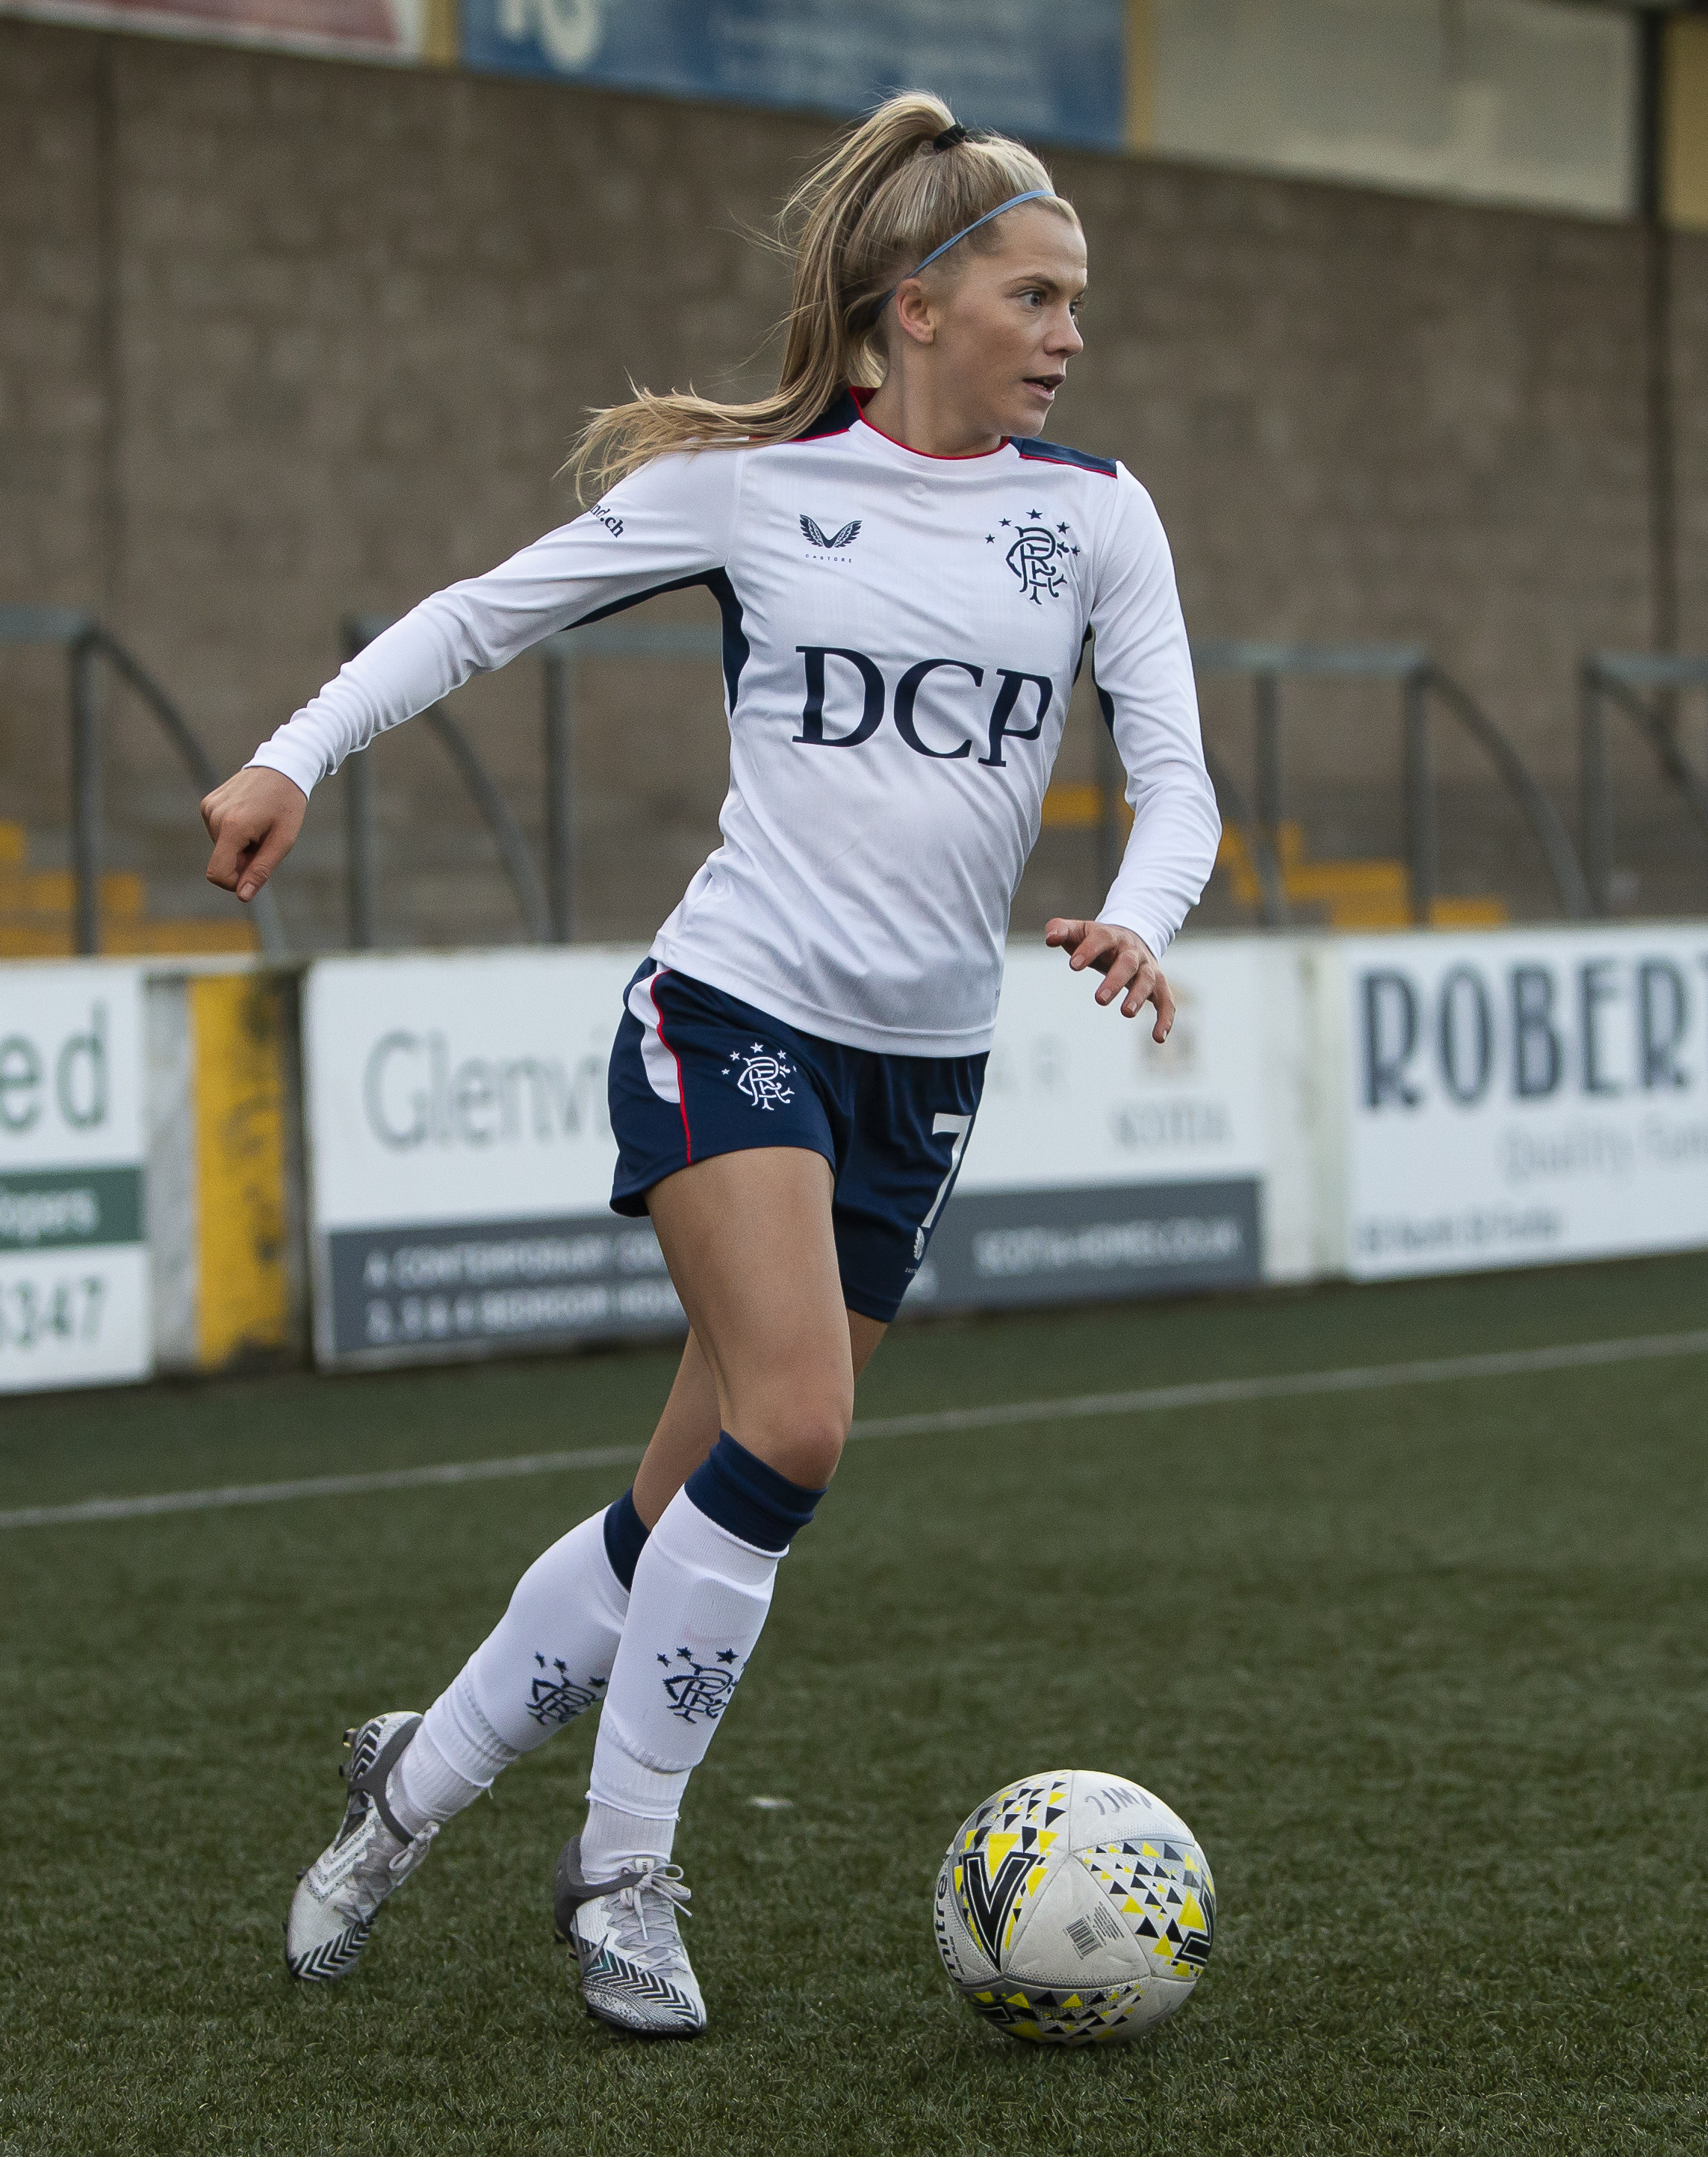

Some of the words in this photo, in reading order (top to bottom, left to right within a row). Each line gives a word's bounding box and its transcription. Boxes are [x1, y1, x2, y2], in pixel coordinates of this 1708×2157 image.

[805, 553, 852, 564] CASTORE
[792, 645, 1053, 767] DCP
[363, 1026, 615, 1152] Glenvi
[1358, 952, 1708, 1110] ROBER
[932, 1112, 972, 1228] 7
